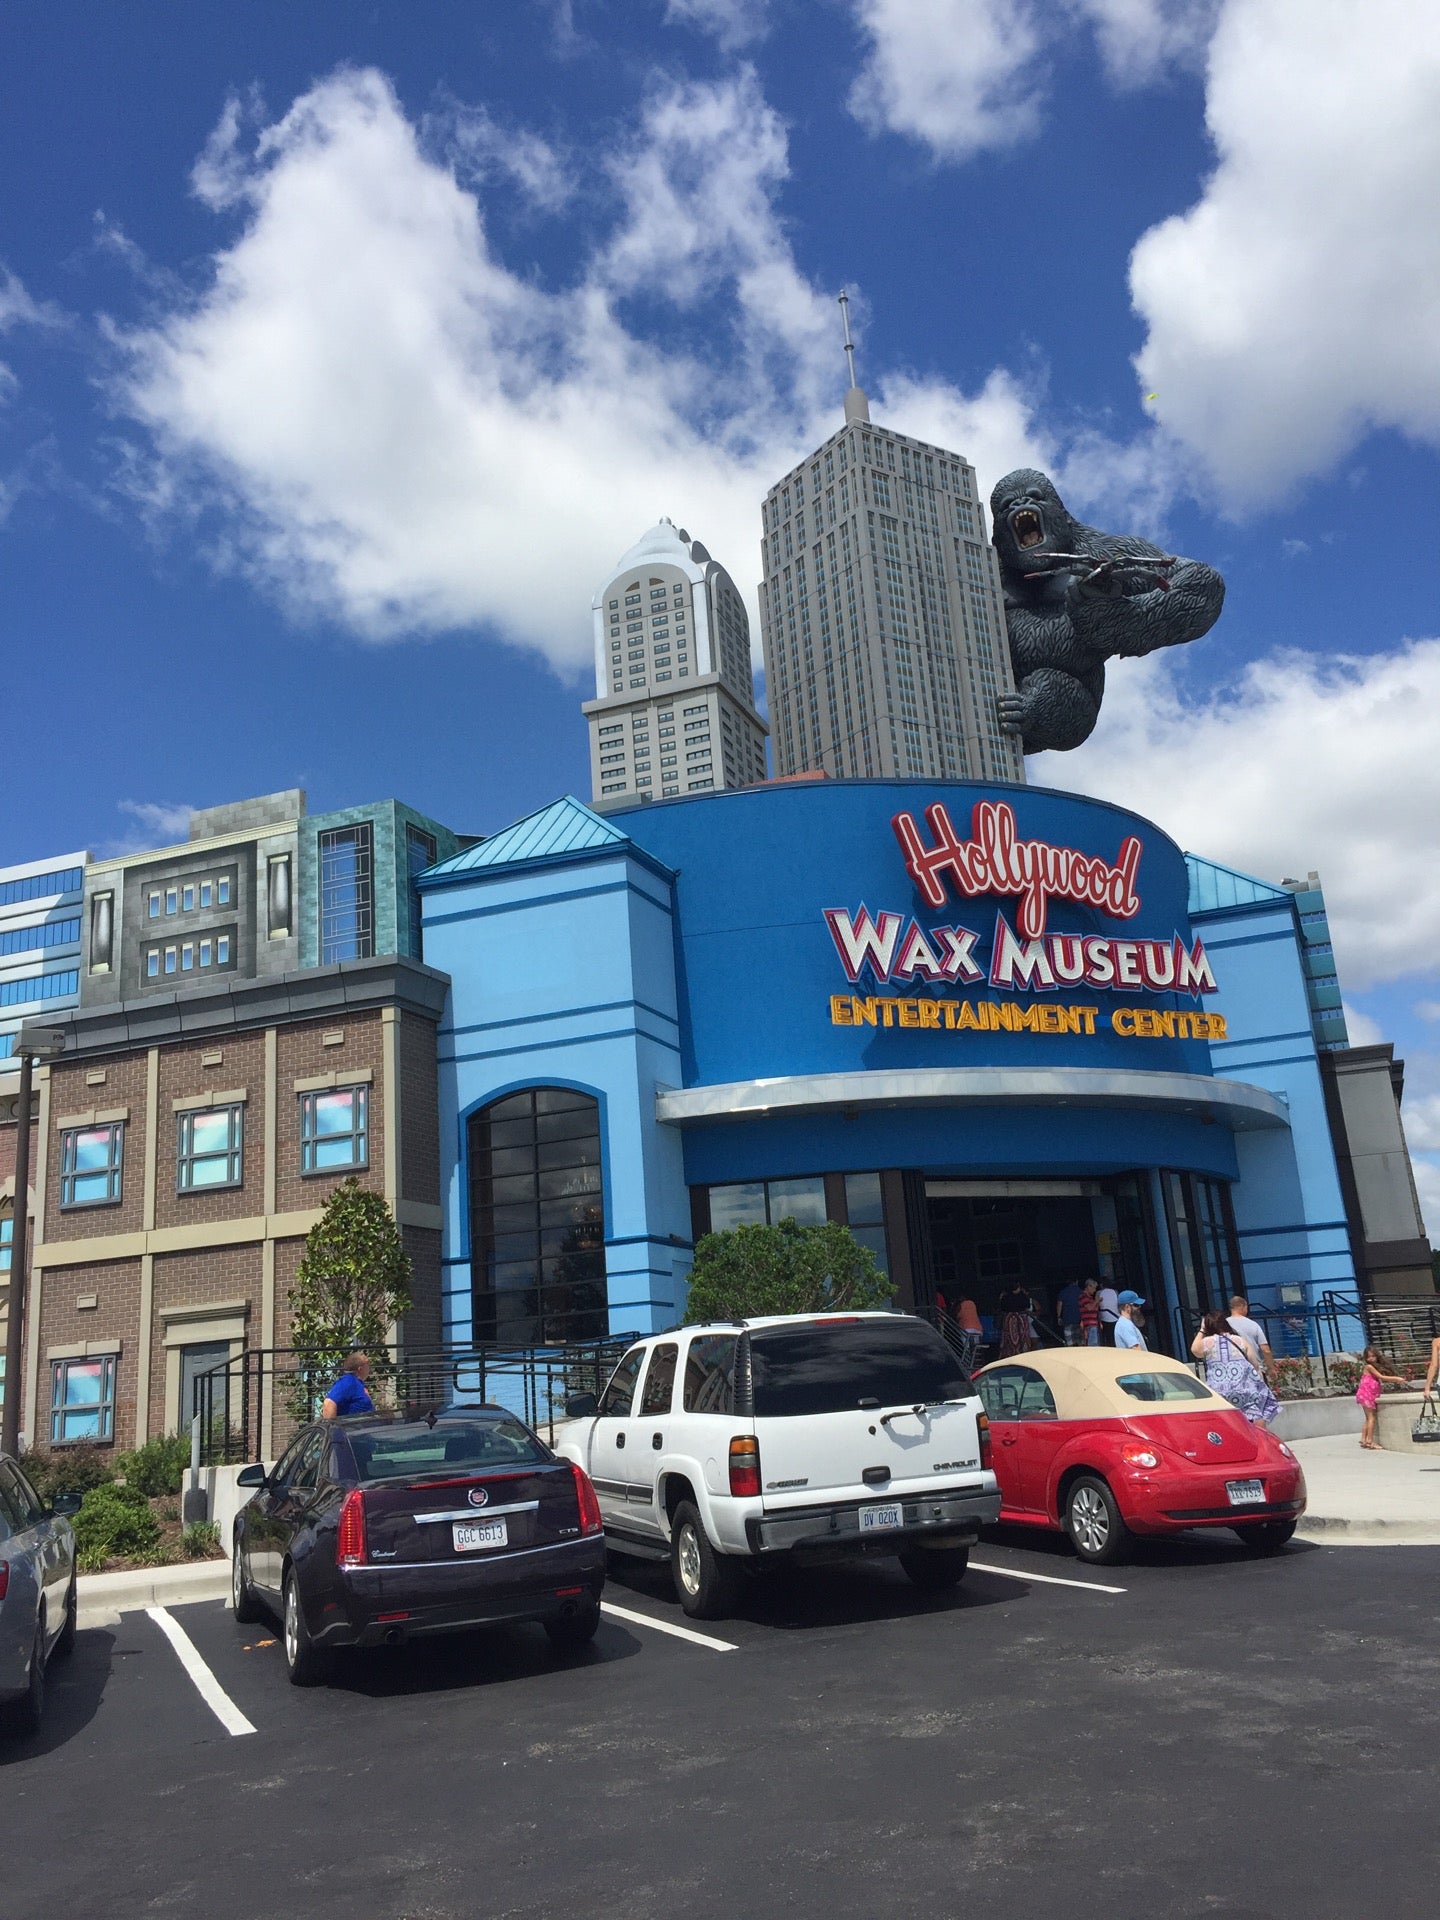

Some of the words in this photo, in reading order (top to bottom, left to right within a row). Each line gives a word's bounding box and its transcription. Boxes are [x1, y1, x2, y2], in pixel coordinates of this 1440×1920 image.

[892, 801, 1142, 939] Hollywood
[824, 902, 985, 984] WAX
[989, 910, 1220, 998] MUSEUM
[830, 995, 1099, 1035] ENTERTAINMENT
[1112, 1008, 1229, 1039] CENTER
[933, 1459, 978, 1471] CHEVROLET
[478, 1524, 503, 1542] 6613
